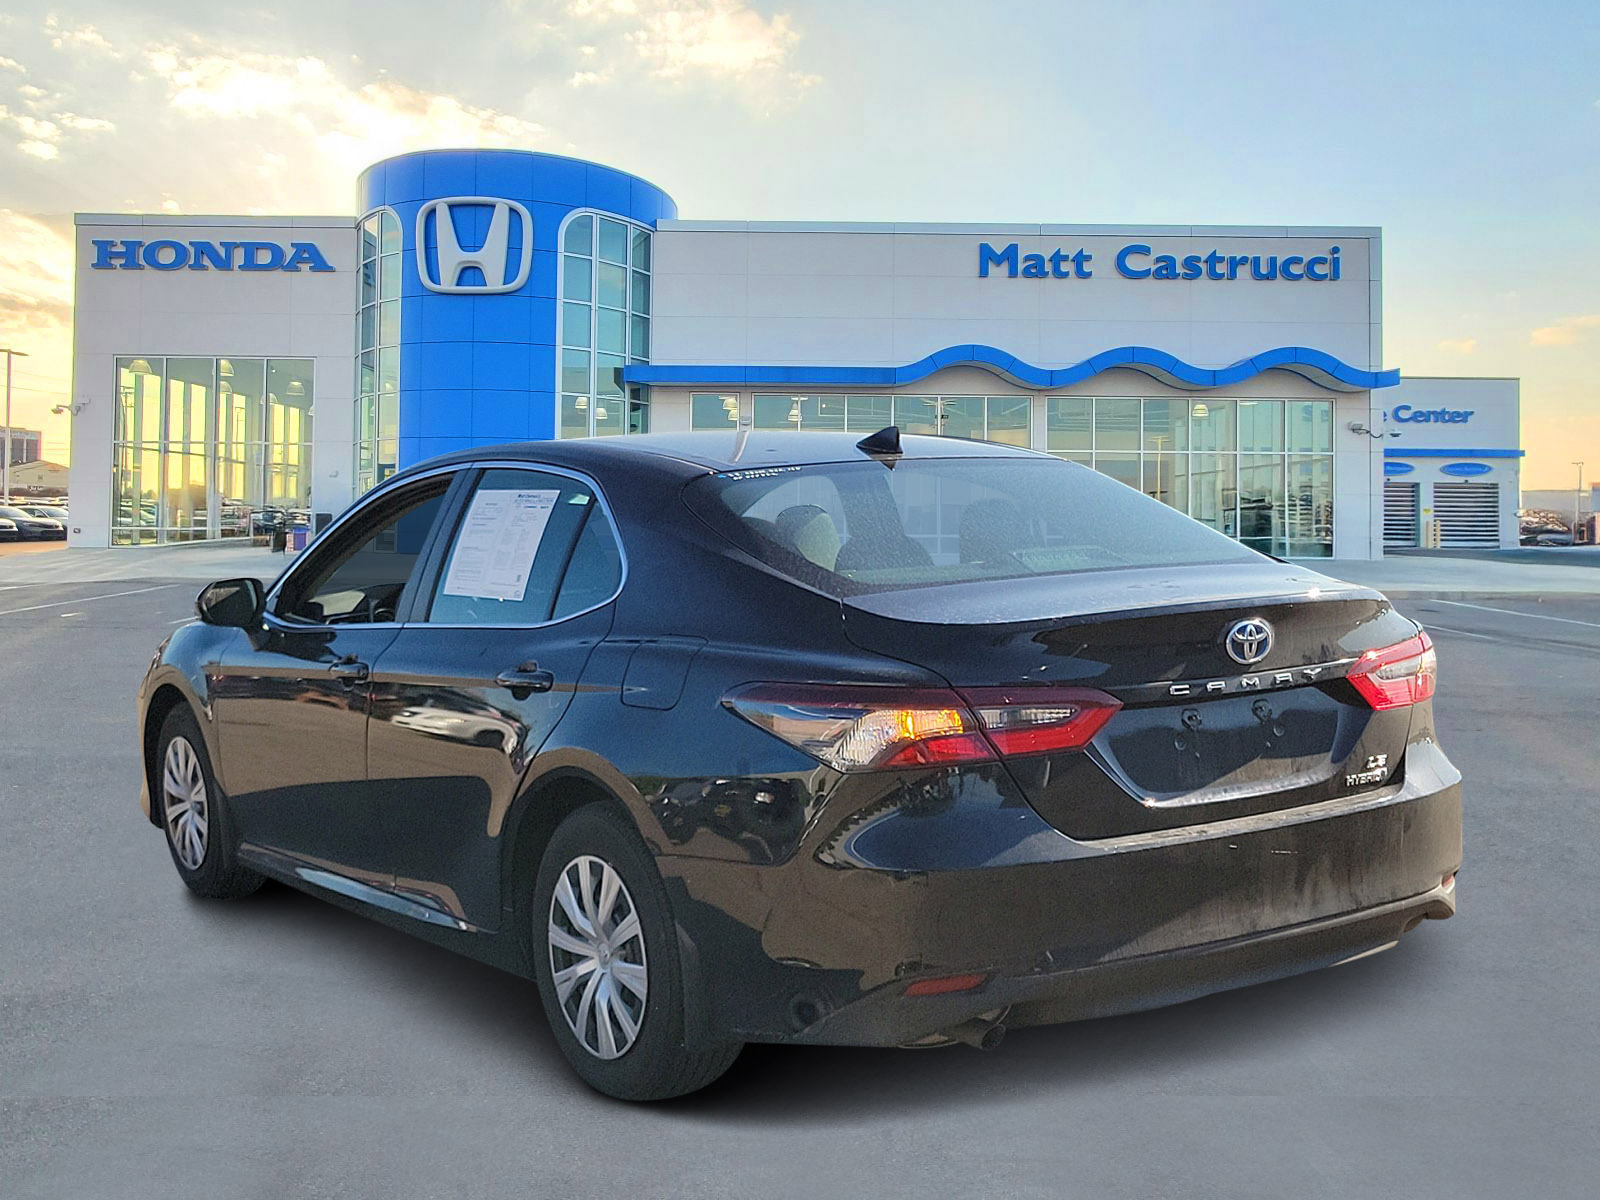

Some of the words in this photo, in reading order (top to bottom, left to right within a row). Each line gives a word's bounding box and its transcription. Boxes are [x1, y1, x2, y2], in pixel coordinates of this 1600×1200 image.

[91, 239, 336, 273] HONDA
[978, 242, 1093, 279] Matt
[1114, 244, 1342, 281] Castrucci
[1392, 404, 1475, 424] Center
[1168, 667, 1323, 695] CAMRY
